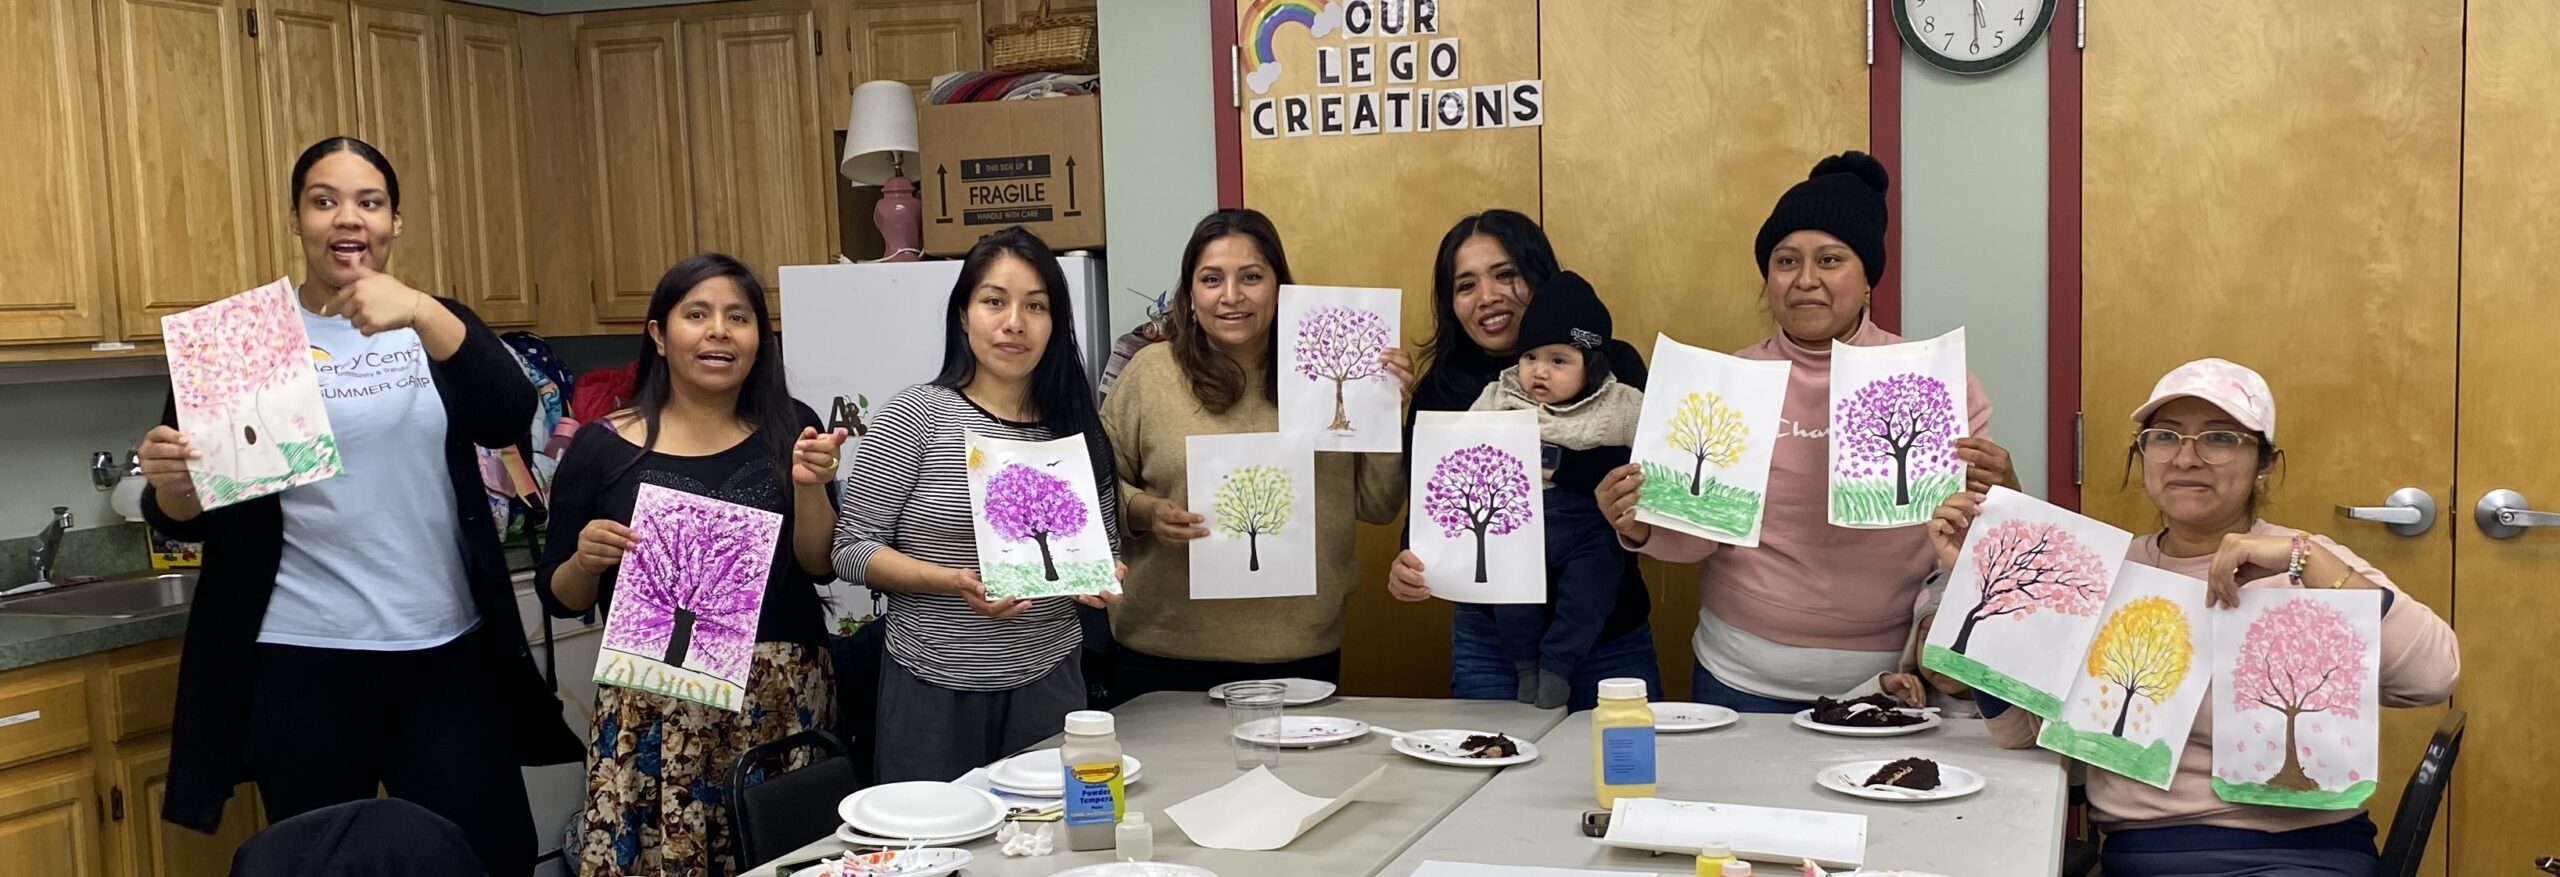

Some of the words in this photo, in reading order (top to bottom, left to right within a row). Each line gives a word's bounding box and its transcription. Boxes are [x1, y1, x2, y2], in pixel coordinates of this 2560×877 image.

[1345, 0, 1436, 34] OUR
[1923, 16, 1935, 33] 8
[2013, 8, 2025, 26] 4
[1943, 32, 1955, 51] 7
[1969, 38, 1980, 55] 6
[1992, 31, 2004, 48] 5
[1318, 43, 1457, 84] LEGO
[1253, 84, 1539, 137] CREATIONS
[985, 163, 999, 172] THIS
[969, 183, 1045, 205] FRAGILE
[977, 211, 1004, 220] HANDLE
[1004, 210, 1020, 219] WITH
[1020, 209, 1039, 218] CARE
[1777, 418, 1829, 438] Cha
[1080, 796, 1113, 804] Tempera
[1081, 788, 1112, 797] Powder
